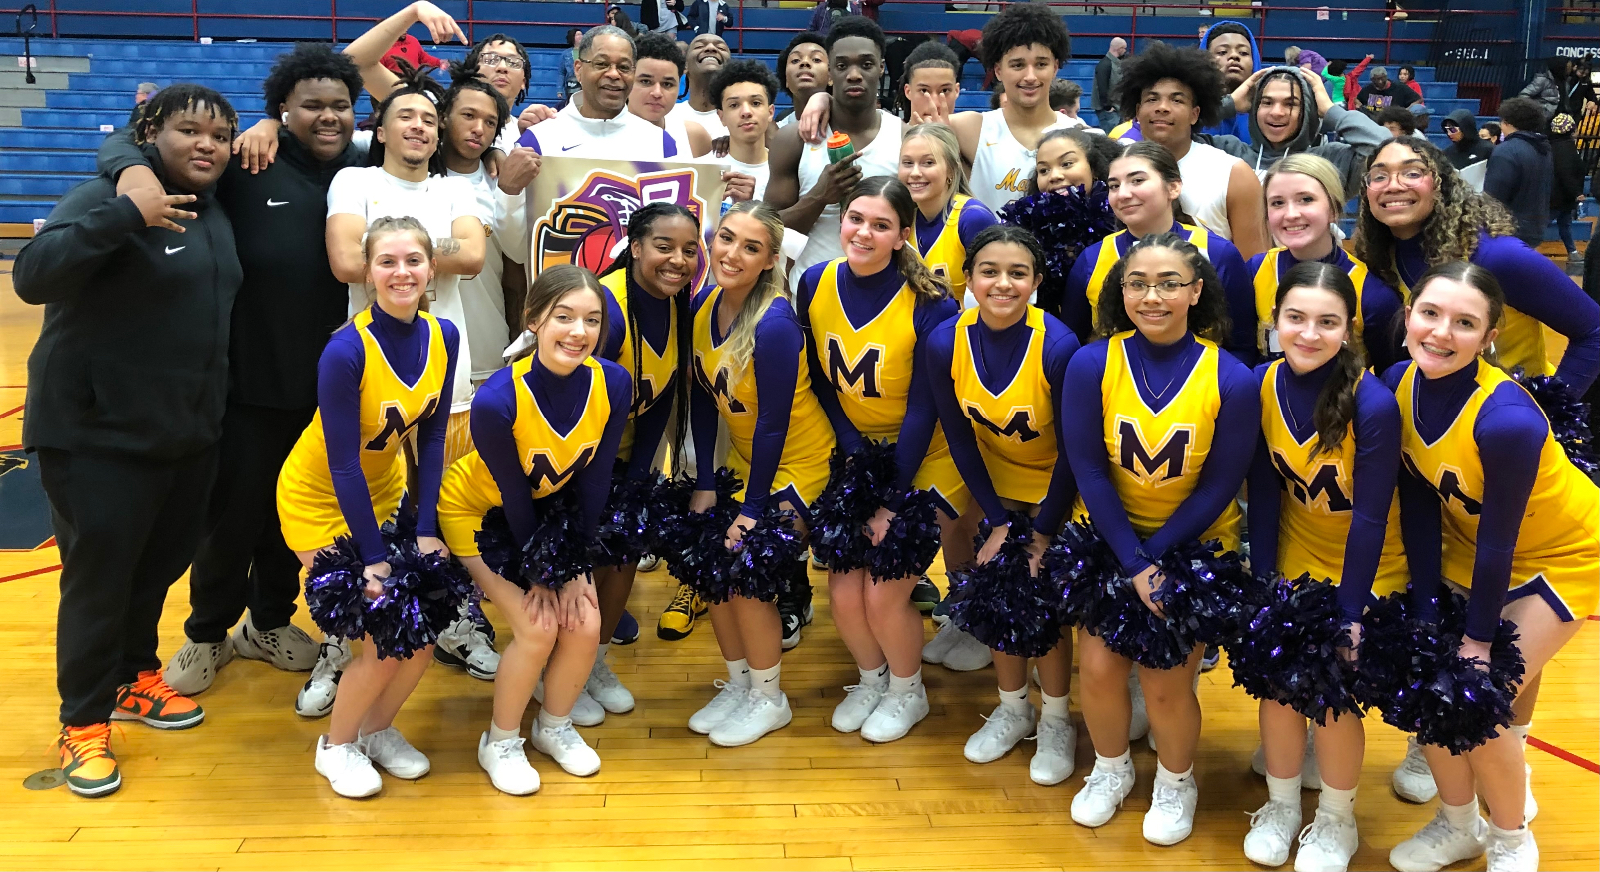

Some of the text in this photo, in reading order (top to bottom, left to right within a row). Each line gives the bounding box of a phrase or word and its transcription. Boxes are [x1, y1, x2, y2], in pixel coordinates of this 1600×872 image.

[694, 347, 753, 416] M
[824, 331, 887, 401] M
[361, 391, 441, 453] M
[962, 398, 1045, 446] M
[1113, 413, 1197, 489] M
[524, 438, 600, 495] M
[1271, 446, 1354, 516] M
